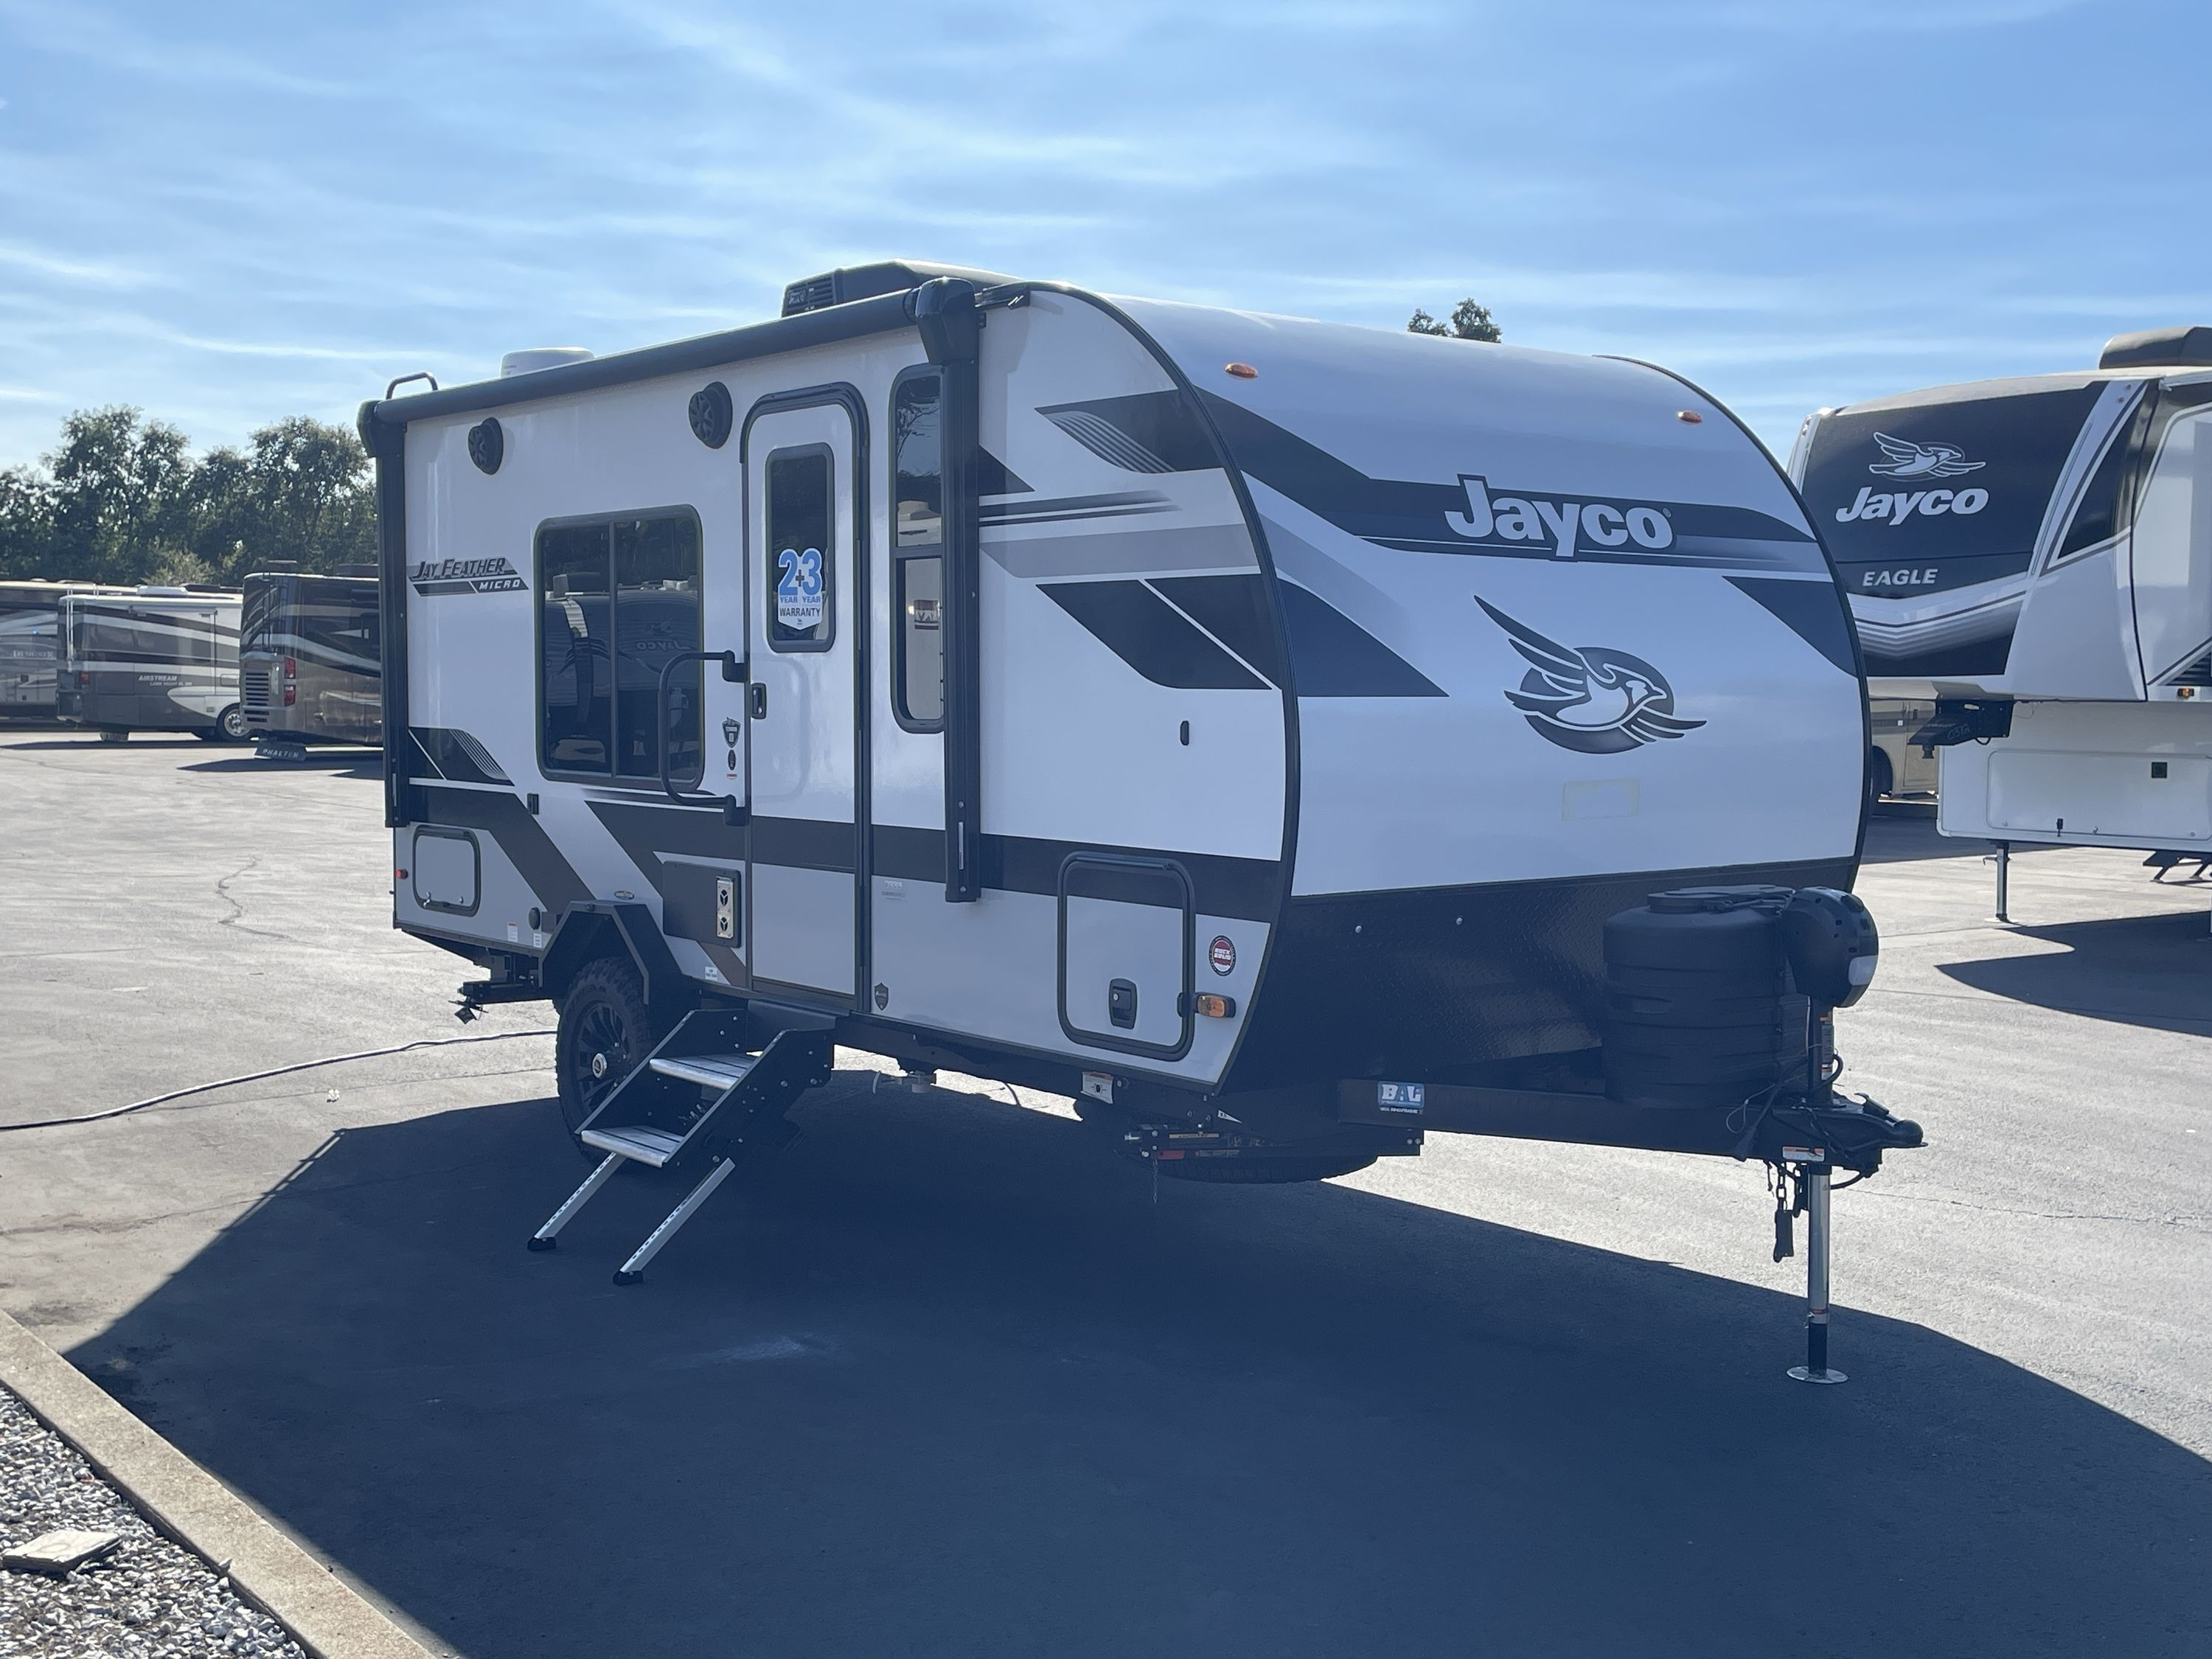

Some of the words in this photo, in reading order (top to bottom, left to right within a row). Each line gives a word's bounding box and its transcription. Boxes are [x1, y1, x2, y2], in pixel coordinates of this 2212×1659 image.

[1836, 487, 1989, 526] Jayco
[1444, 479, 1673, 557] Jayco
[442, 557, 506, 579] FEATHER
[1863, 568, 1938, 587] EAGLE
[479, 579, 521, 590] MICRO
[779, 608, 821, 616] WARRANTY
[1382, 1084, 1422, 1102] BAL
